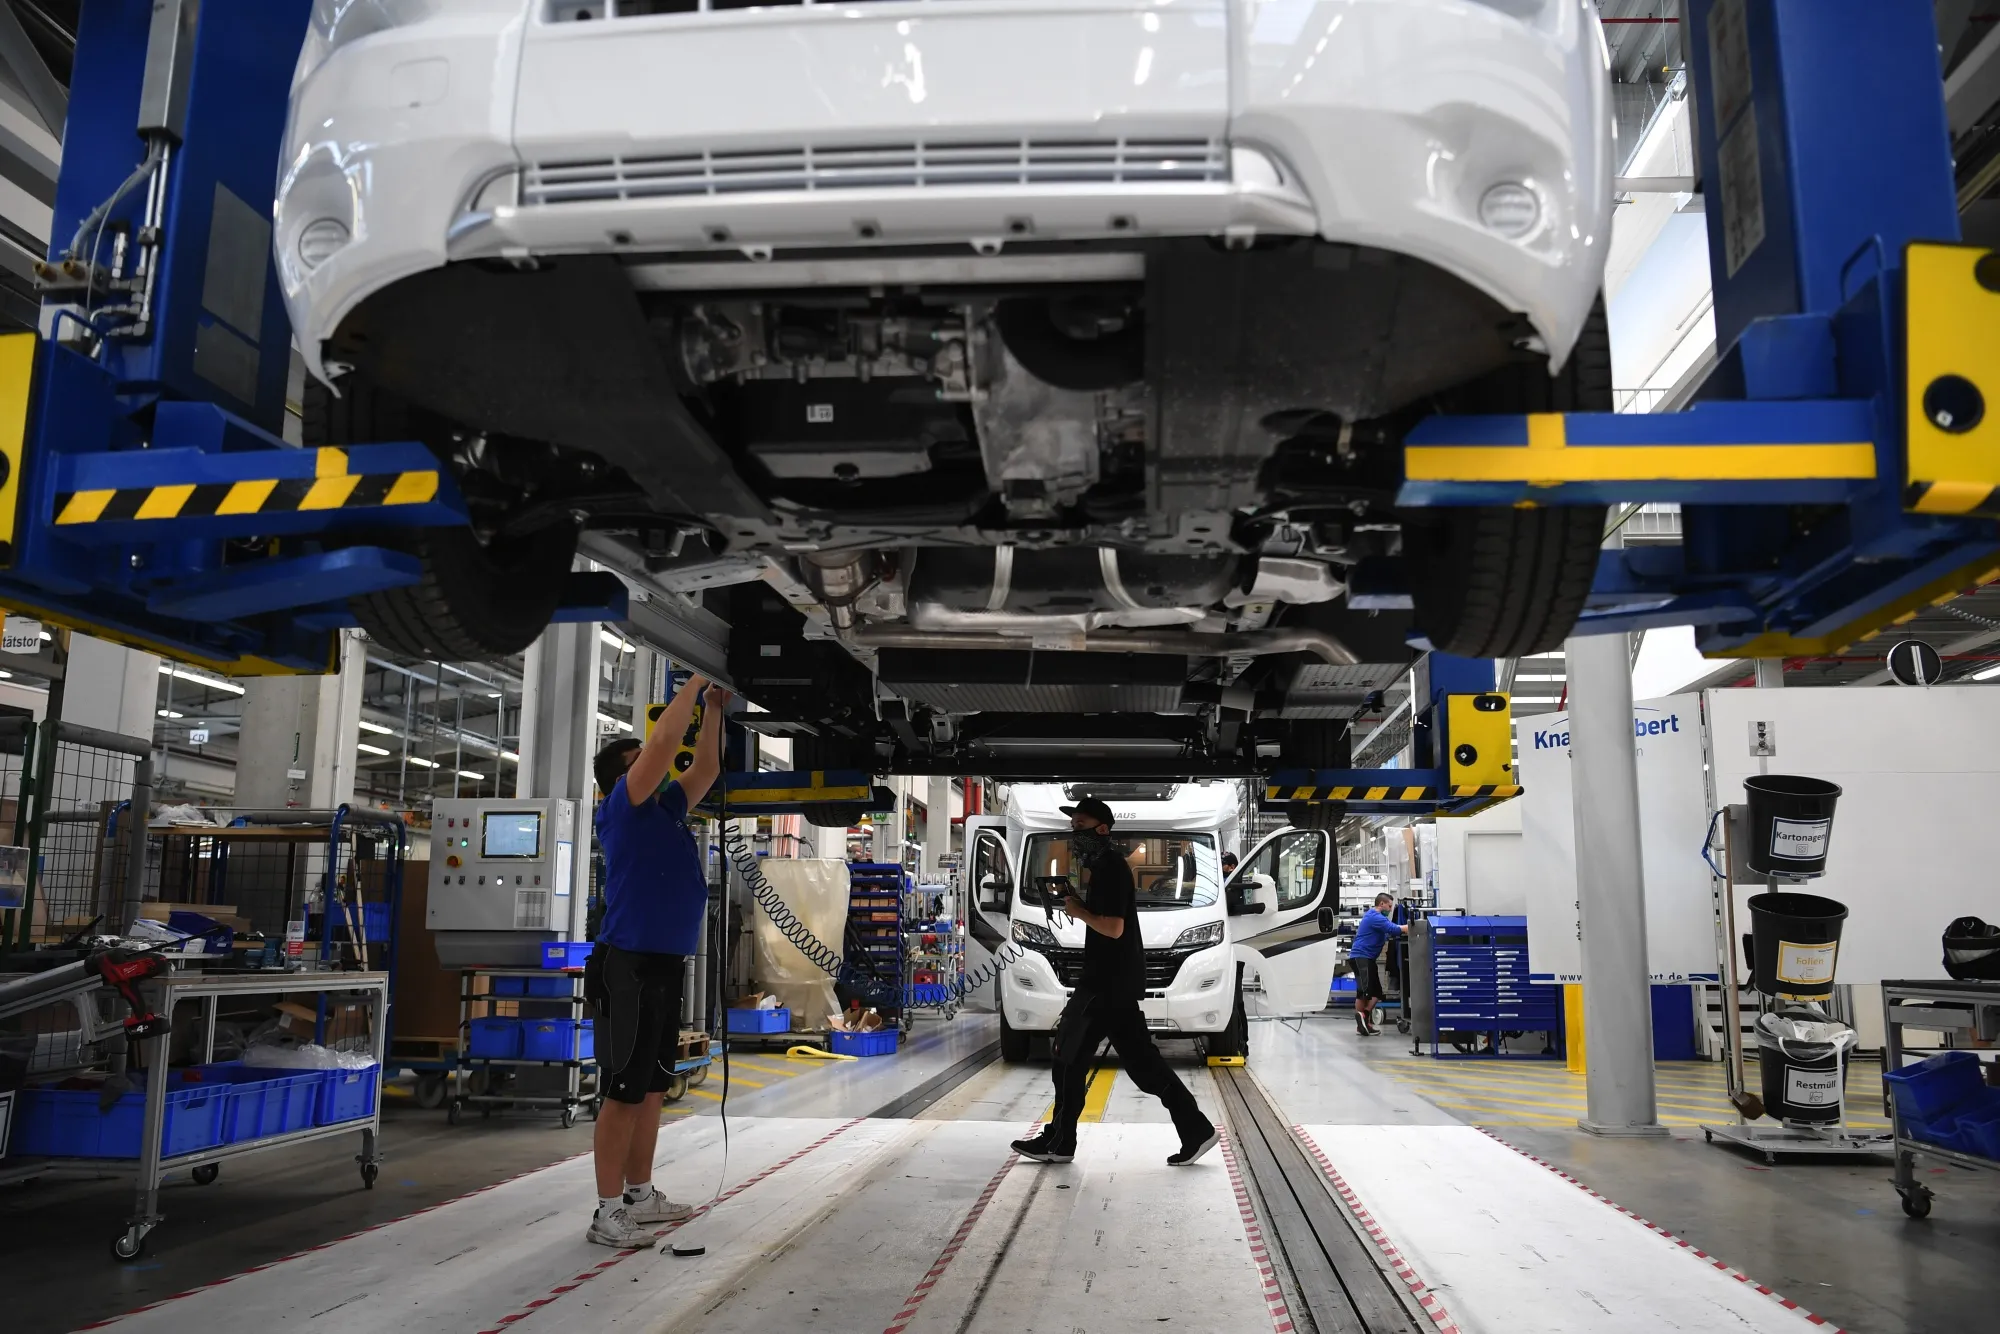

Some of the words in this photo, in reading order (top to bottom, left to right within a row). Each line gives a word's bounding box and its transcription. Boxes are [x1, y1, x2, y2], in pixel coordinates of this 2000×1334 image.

[2, 635, 38, 648] tätstor
[603, 723, 615, 732] BZ
[1534, 731, 1570, 749] Kna
[1635, 714, 1679, 737] bert
[1776, 831, 1826, 843] Kartonagen
[1796, 957, 1824, 965] Folien
[1796, 1080, 1836, 1089] Restmüll
